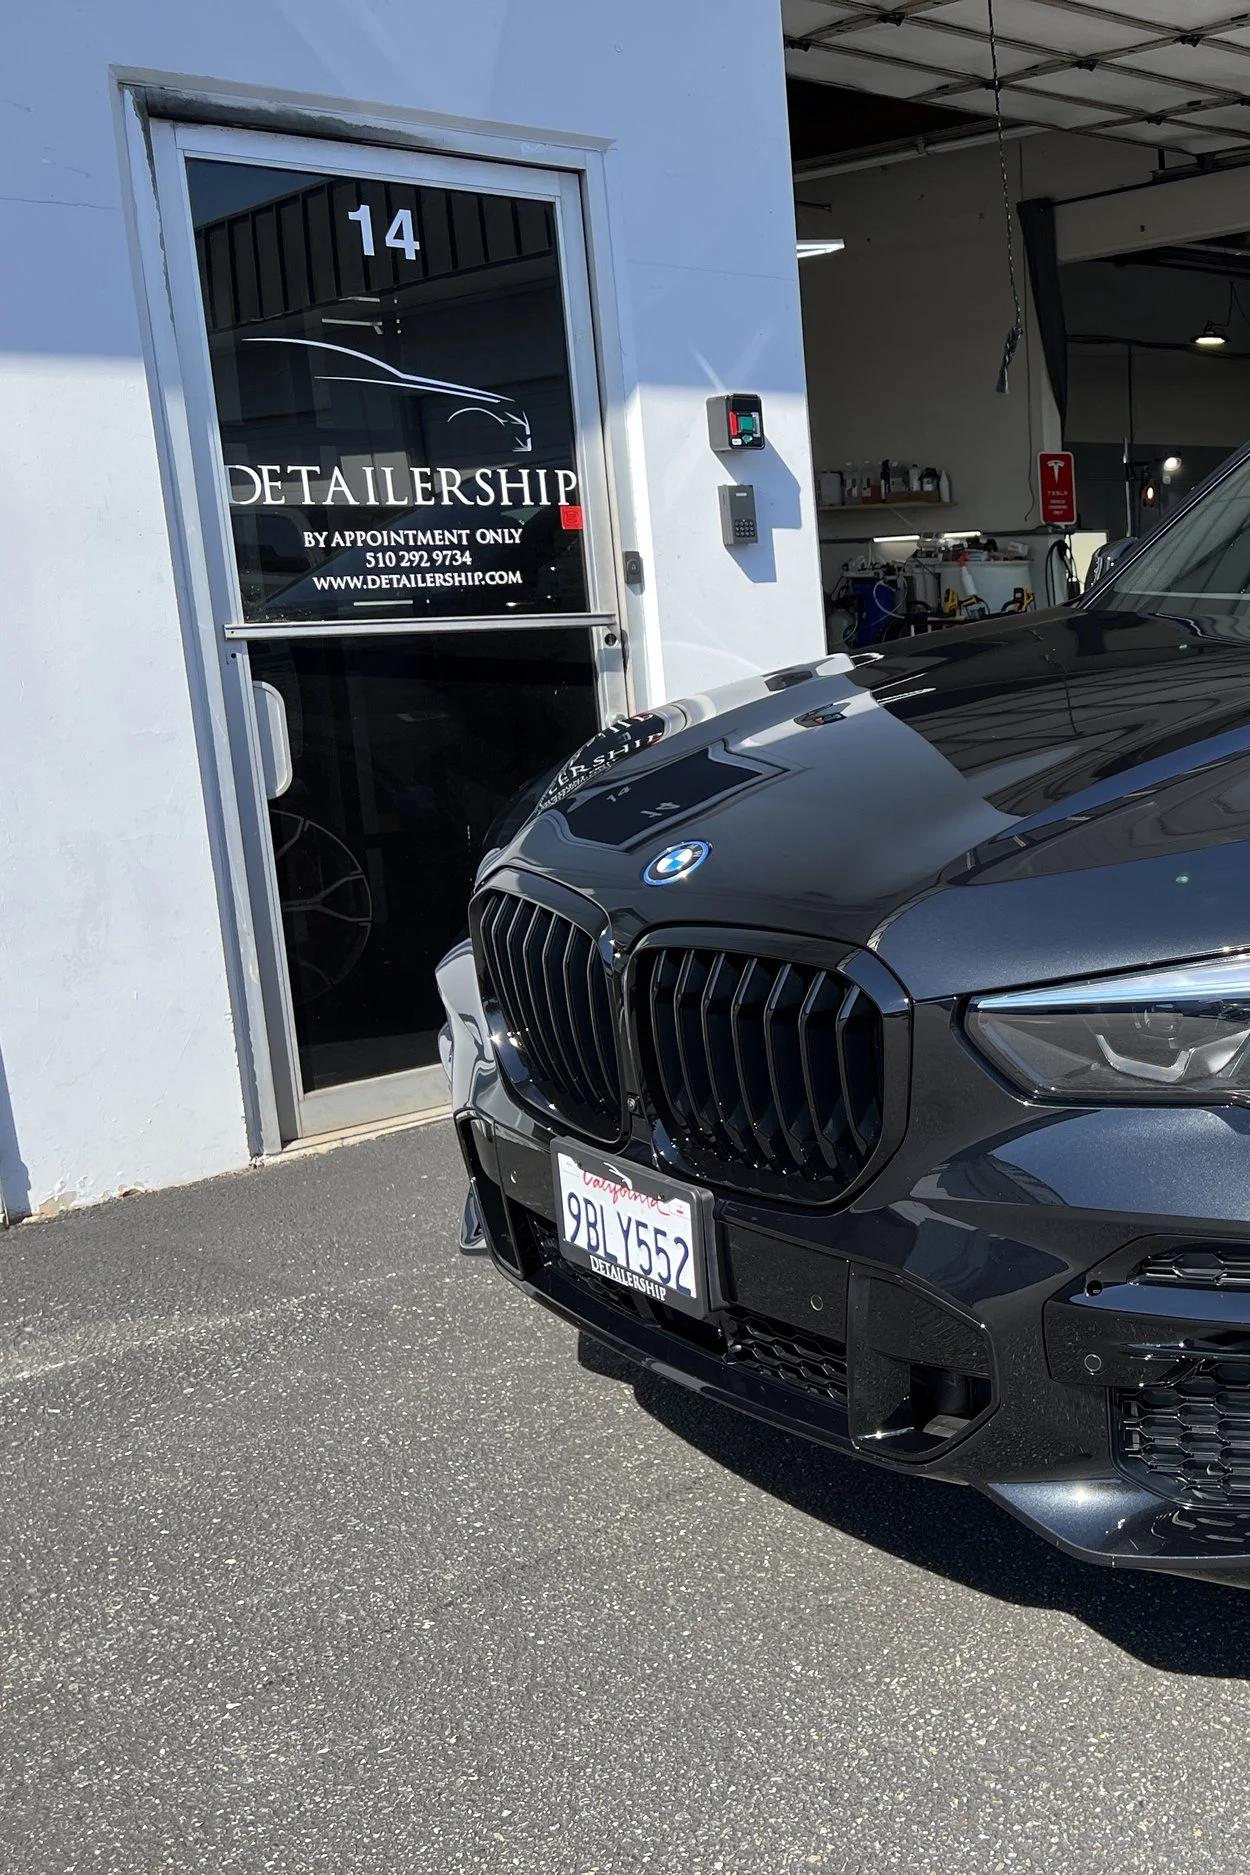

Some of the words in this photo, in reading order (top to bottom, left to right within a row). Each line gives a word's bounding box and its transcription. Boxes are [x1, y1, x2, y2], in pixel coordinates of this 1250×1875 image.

[347, 204, 420, 260] 14
[224, 464, 577, 506] DETAILERSHIP
[303, 531, 328, 548] BY
[331, 529, 470, 547] APPOINTMENT
[475, 528, 523, 544] ONLY
[365, 552, 397, 568] 510
[399, 551, 430, 568] 292
[432, 549, 472, 567] 9734
[311, 570, 523, 590] WWW.DETAILERSHIP.COM
[567, 1191, 692, 1297] 9BLY552
[589, 1254, 667, 1301] DETAILERSHIP
